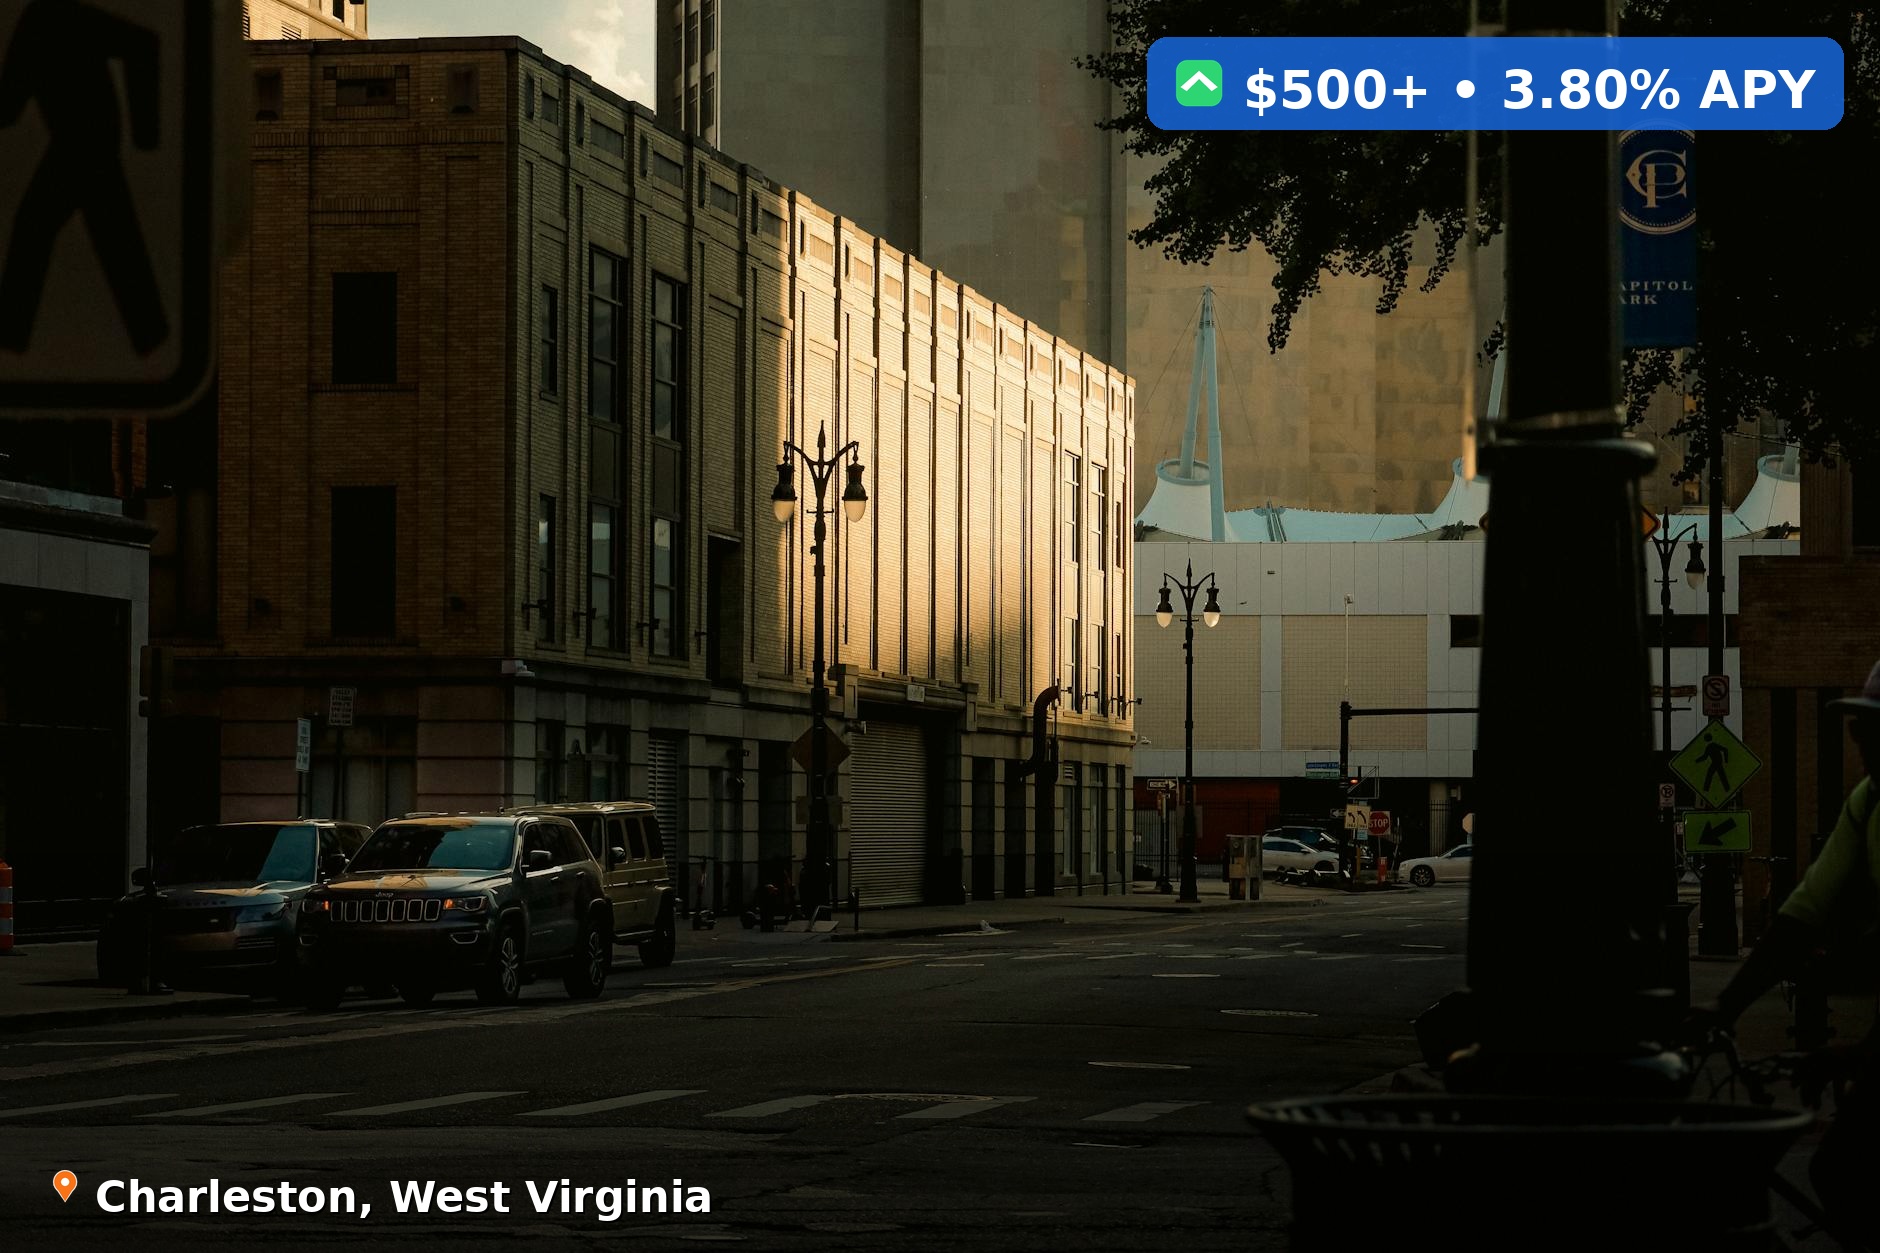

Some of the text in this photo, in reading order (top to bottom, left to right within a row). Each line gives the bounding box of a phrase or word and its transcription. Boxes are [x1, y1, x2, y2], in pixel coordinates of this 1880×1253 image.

[1620, 280, 1694, 292] APITOL
[1619, 294, 1658, 305] ARK
[1368, 818, 1389, 828] STOP
